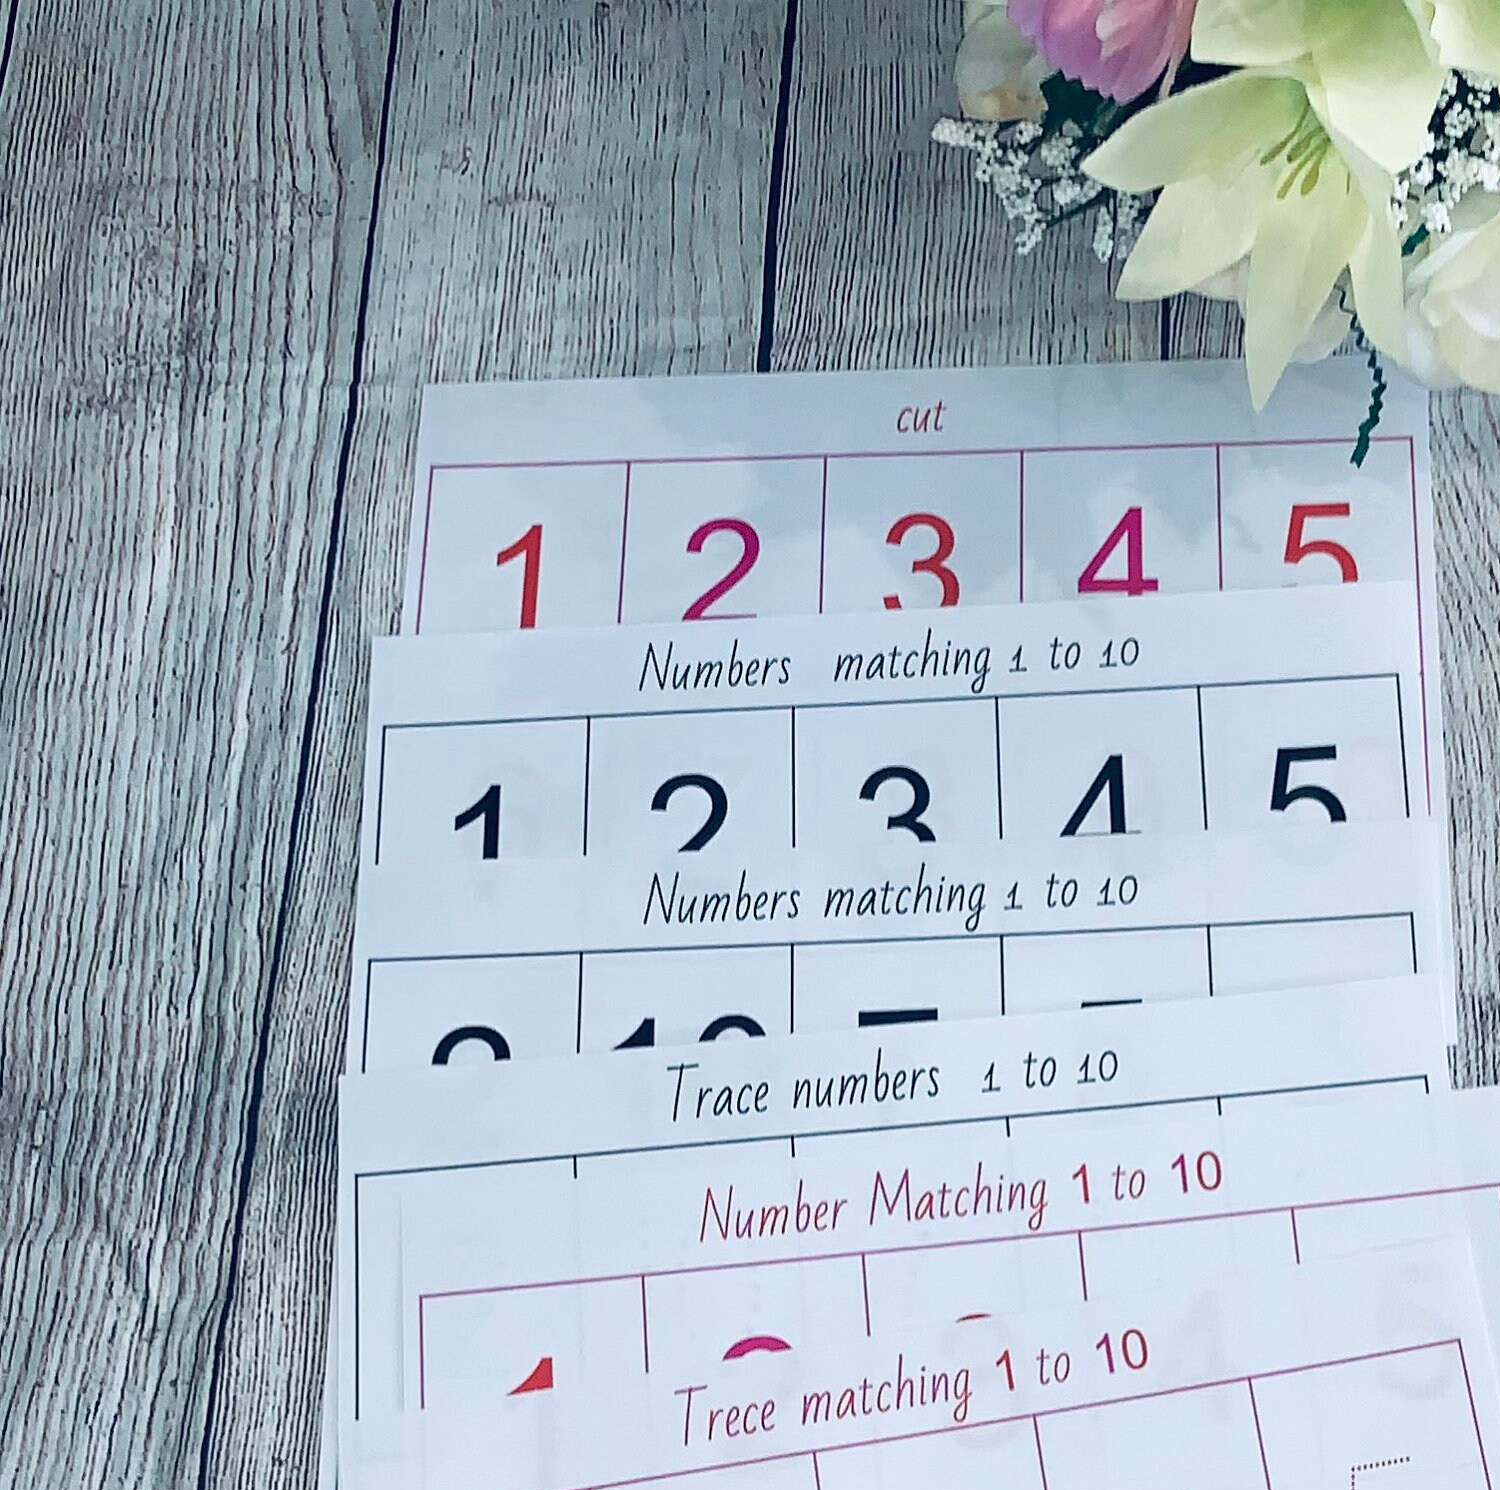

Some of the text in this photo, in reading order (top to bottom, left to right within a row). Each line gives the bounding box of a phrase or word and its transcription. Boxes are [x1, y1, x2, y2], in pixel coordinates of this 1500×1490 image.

[896, 400, 943, 433] cut
[496, 524, 543, 629] 1
[681, 518, 760, 621] 2
[883, 513, 960, 610] 3
[1077, 506, 1159, 597] 4
[638, 628, 1140, 694] Numbers matching 1 to 10
[643, 864, 1138, 933] Numbers matching 1 to 10
[666, 1048, 1118, 1123] Trace numbers 1 to 10
[699, 1150, 1222, 1243] Number Matching 1 to 10
[674, 1329, 1148, 1447] Trece matching 1 to 10
